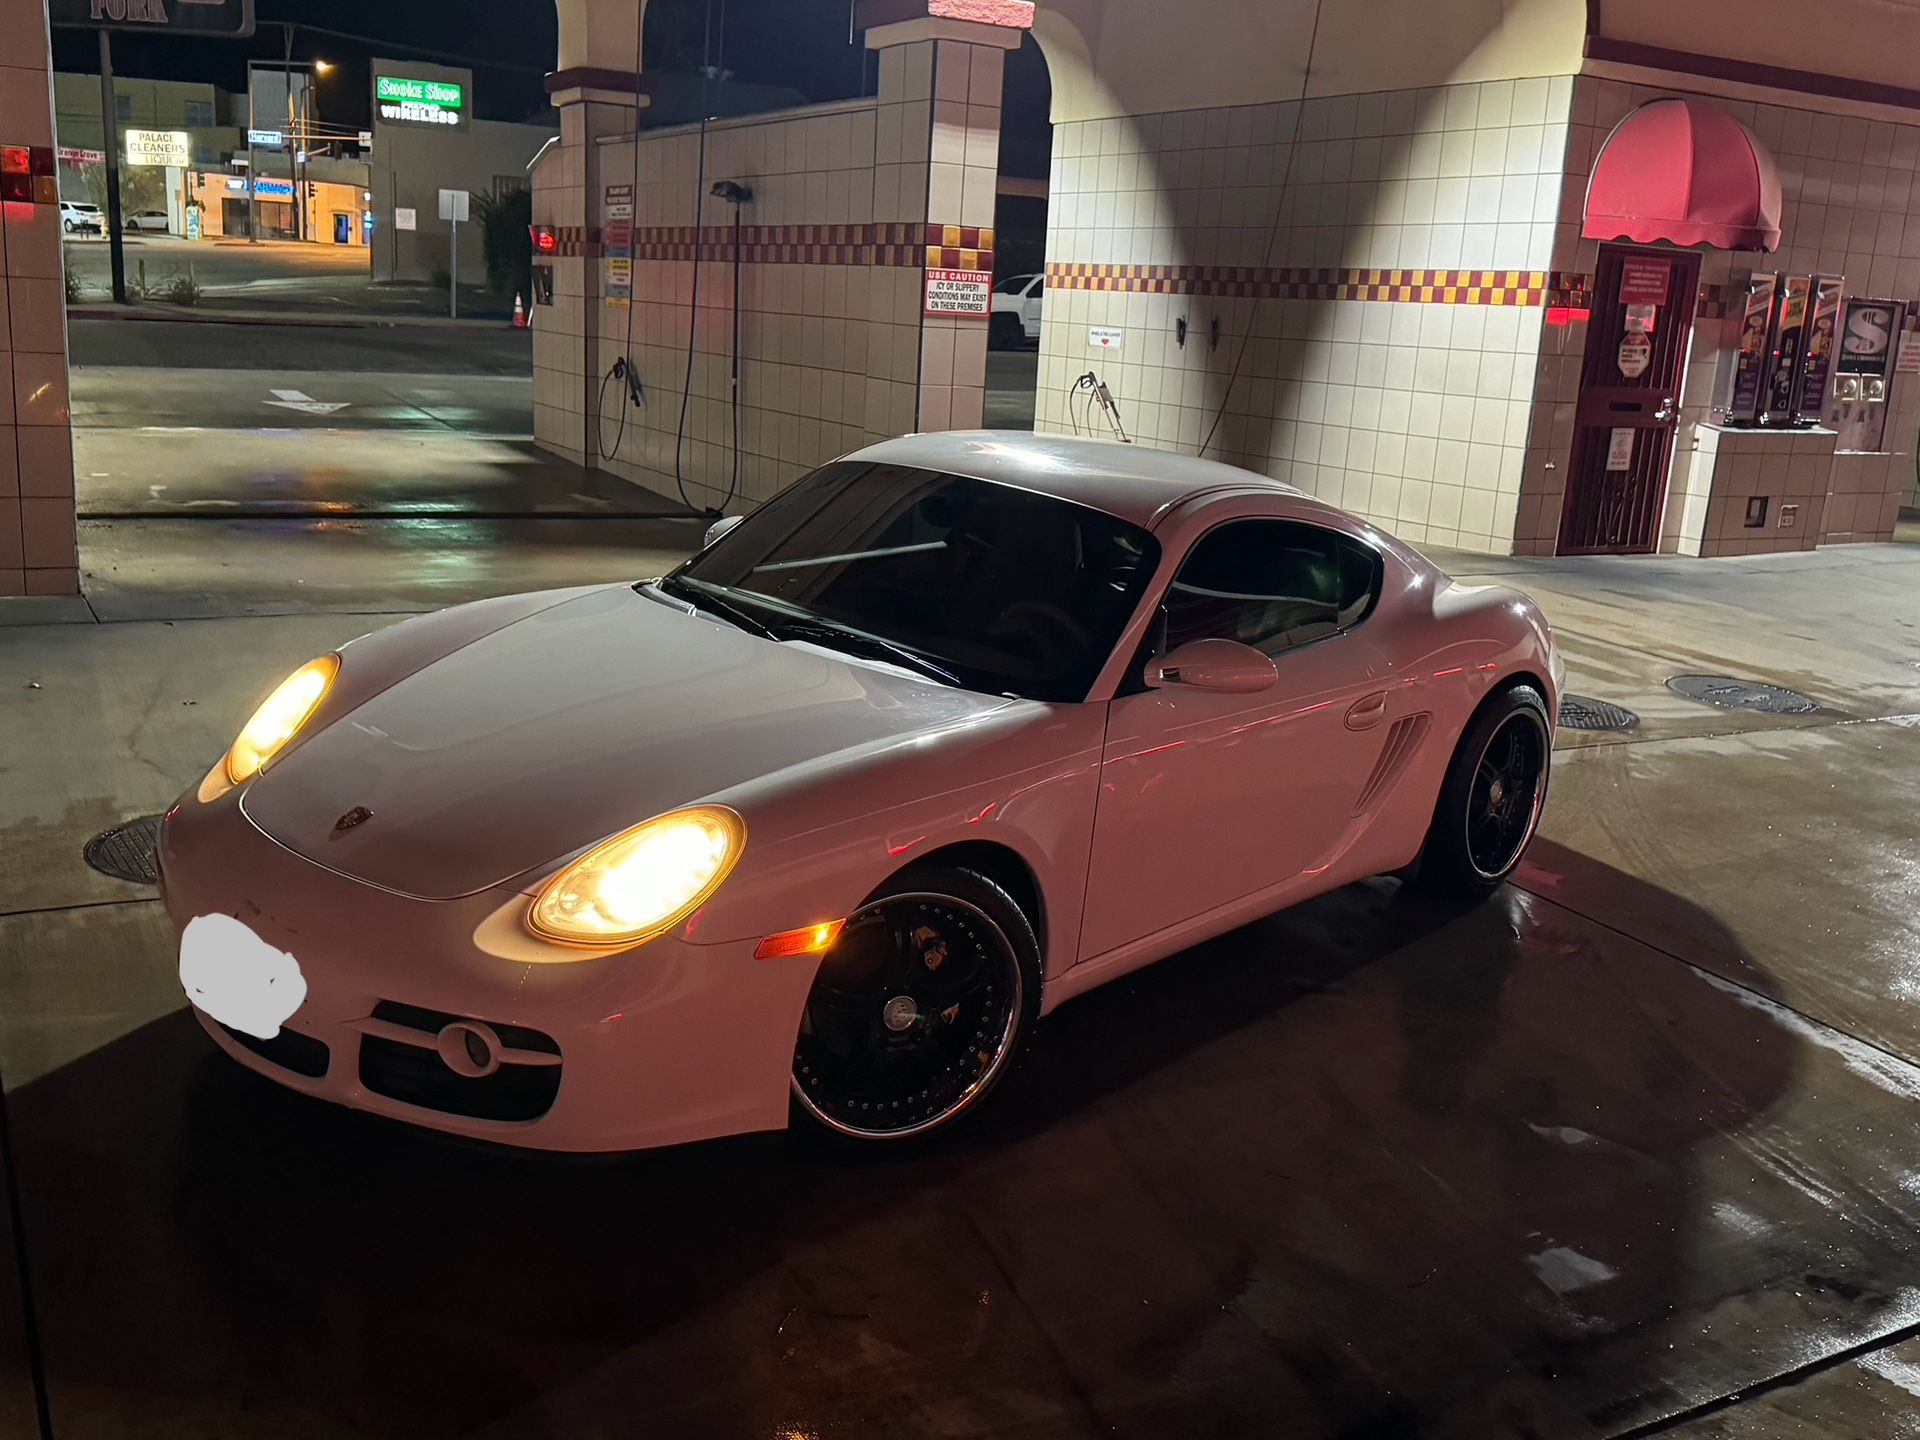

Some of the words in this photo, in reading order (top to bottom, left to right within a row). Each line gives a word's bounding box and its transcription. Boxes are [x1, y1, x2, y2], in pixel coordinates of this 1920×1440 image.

[139, 132, 174, 143] PALACE
[130, 143, 185, 154] CLEANERS
[80, 150, 98, 159] Grove
[928, 271, 946, 279] USE
[949, 272, 989, 282] CAUTION
[936, 282, 945, 290] ICY
[946, 282, 954, 290] OR
[955, 283, 980, 292] SLIPPERY
[928, 291, 959, 301] CONDITIONS
[960, 293, 971, 301] MAY
[972, 294, 987, 302] EXIST
[931, 301, 939, 309] ON
[940, 301, 956, 310] THESE
[957, 302, 983, 311] PREMISES
